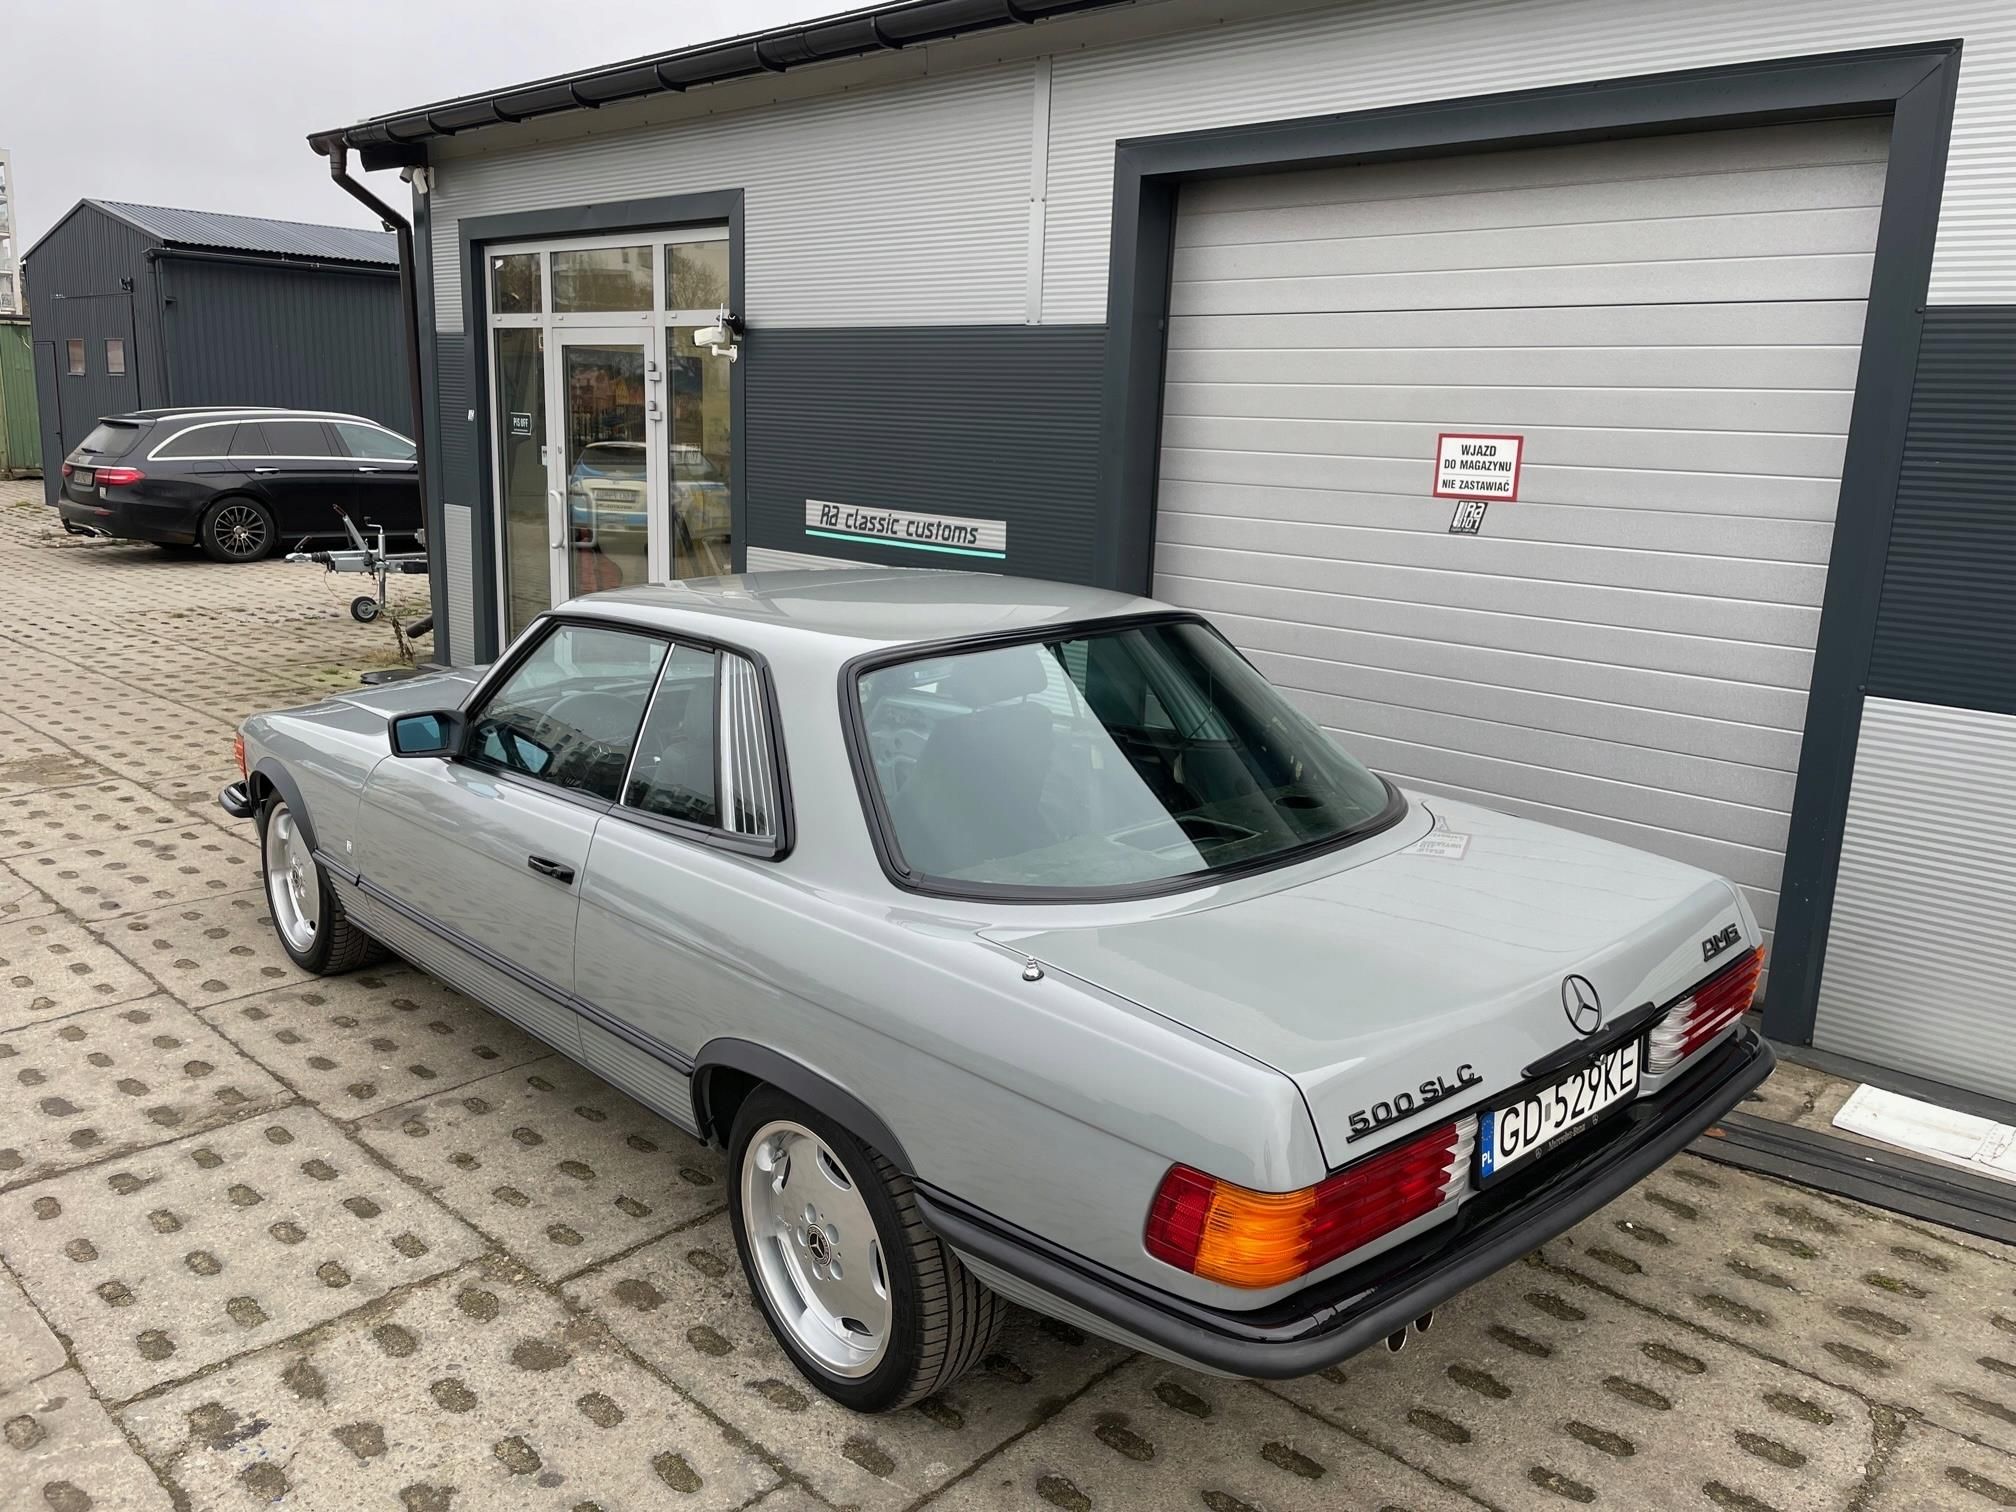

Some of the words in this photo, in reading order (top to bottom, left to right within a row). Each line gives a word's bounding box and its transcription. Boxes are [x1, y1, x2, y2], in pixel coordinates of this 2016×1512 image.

[1461, 444, 1497, 457] WJAZD
[1444, 459, 1456, 469] DO
[1459, 460, 1512, 472] MAGAZYNU
[1442, 479, 1456, 489] NIE
[1459, 480, 1510, 492] ZASTAWIAĆ
[844, 508, 900, 535] classic
[905, 520, 979, 545] customs
[1702, 922, 1742, 962] AMG
[1348, 1092, 1415, 1135] 500
[1419, 1063, 1476, 1103] SLC
[1500, 1099, 1542, 1158] GD
[1554, 1044, 1635, 1129] 529KE
[1481, 1150, 1493, 1169] PL
